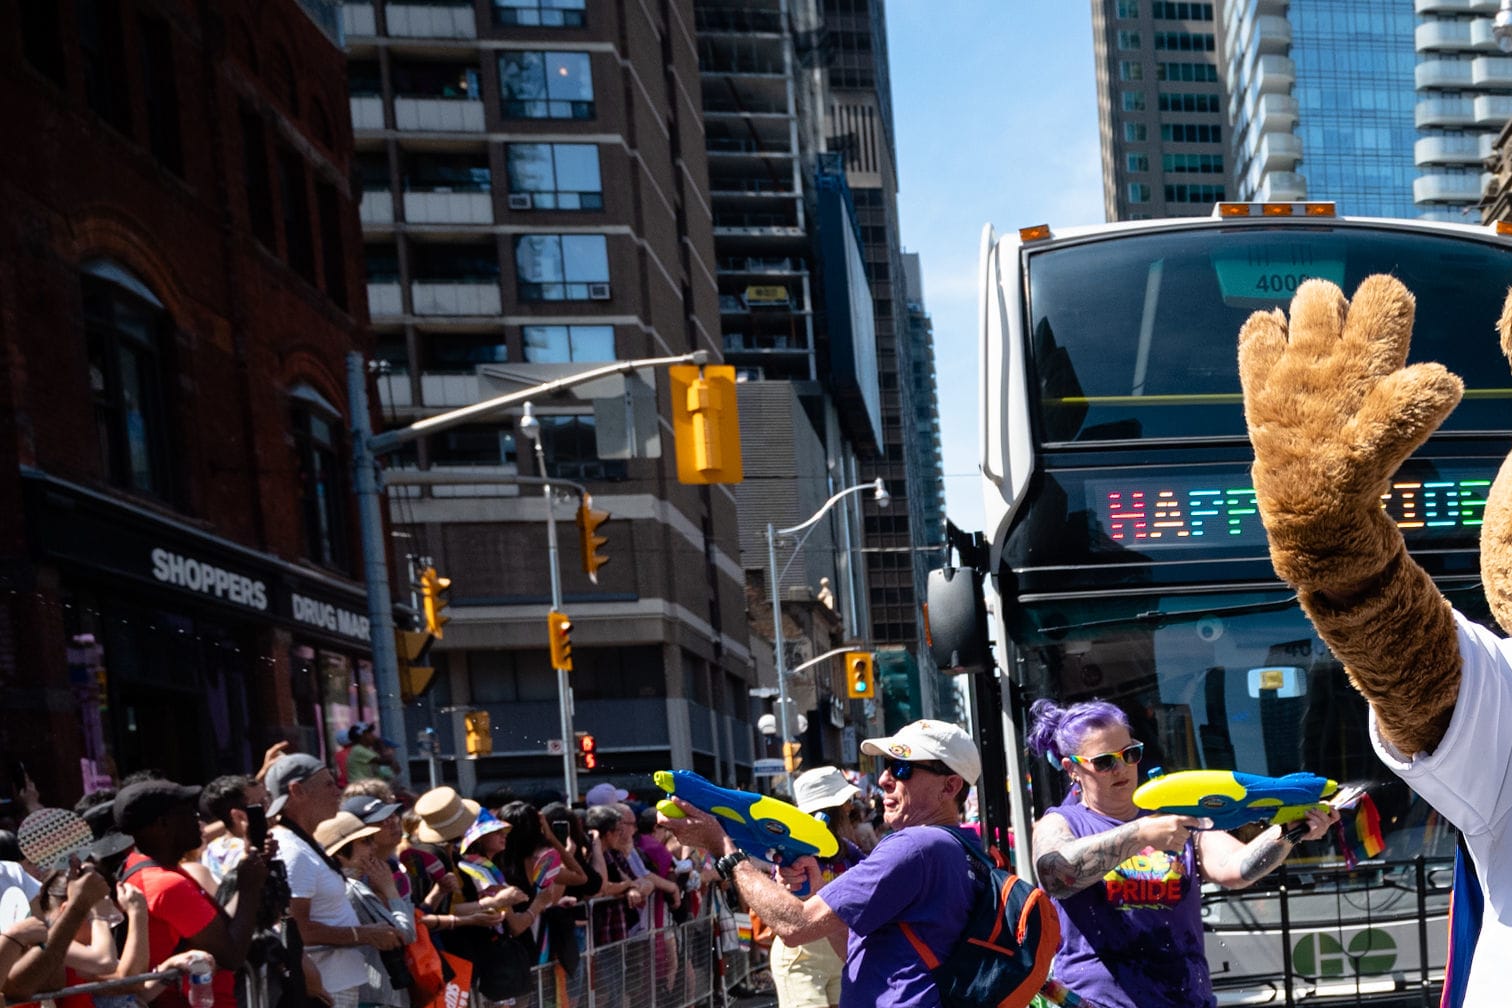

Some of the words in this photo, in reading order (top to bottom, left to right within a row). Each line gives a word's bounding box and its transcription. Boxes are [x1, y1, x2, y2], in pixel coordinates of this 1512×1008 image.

[1255, 273, 1310, 293] 400
[1109, 488, 1259, 538] HAPP
[1380, 481, 1491, 528] IDE
[152, 547, 269, 611] SHOPPERS
[291, 593, 336, 631] DRUG
[336, 607, 372, 642] MAR
[1115, 849, 1171, 873] IDE
[1106, 878, 1182, 903] PRIDE
